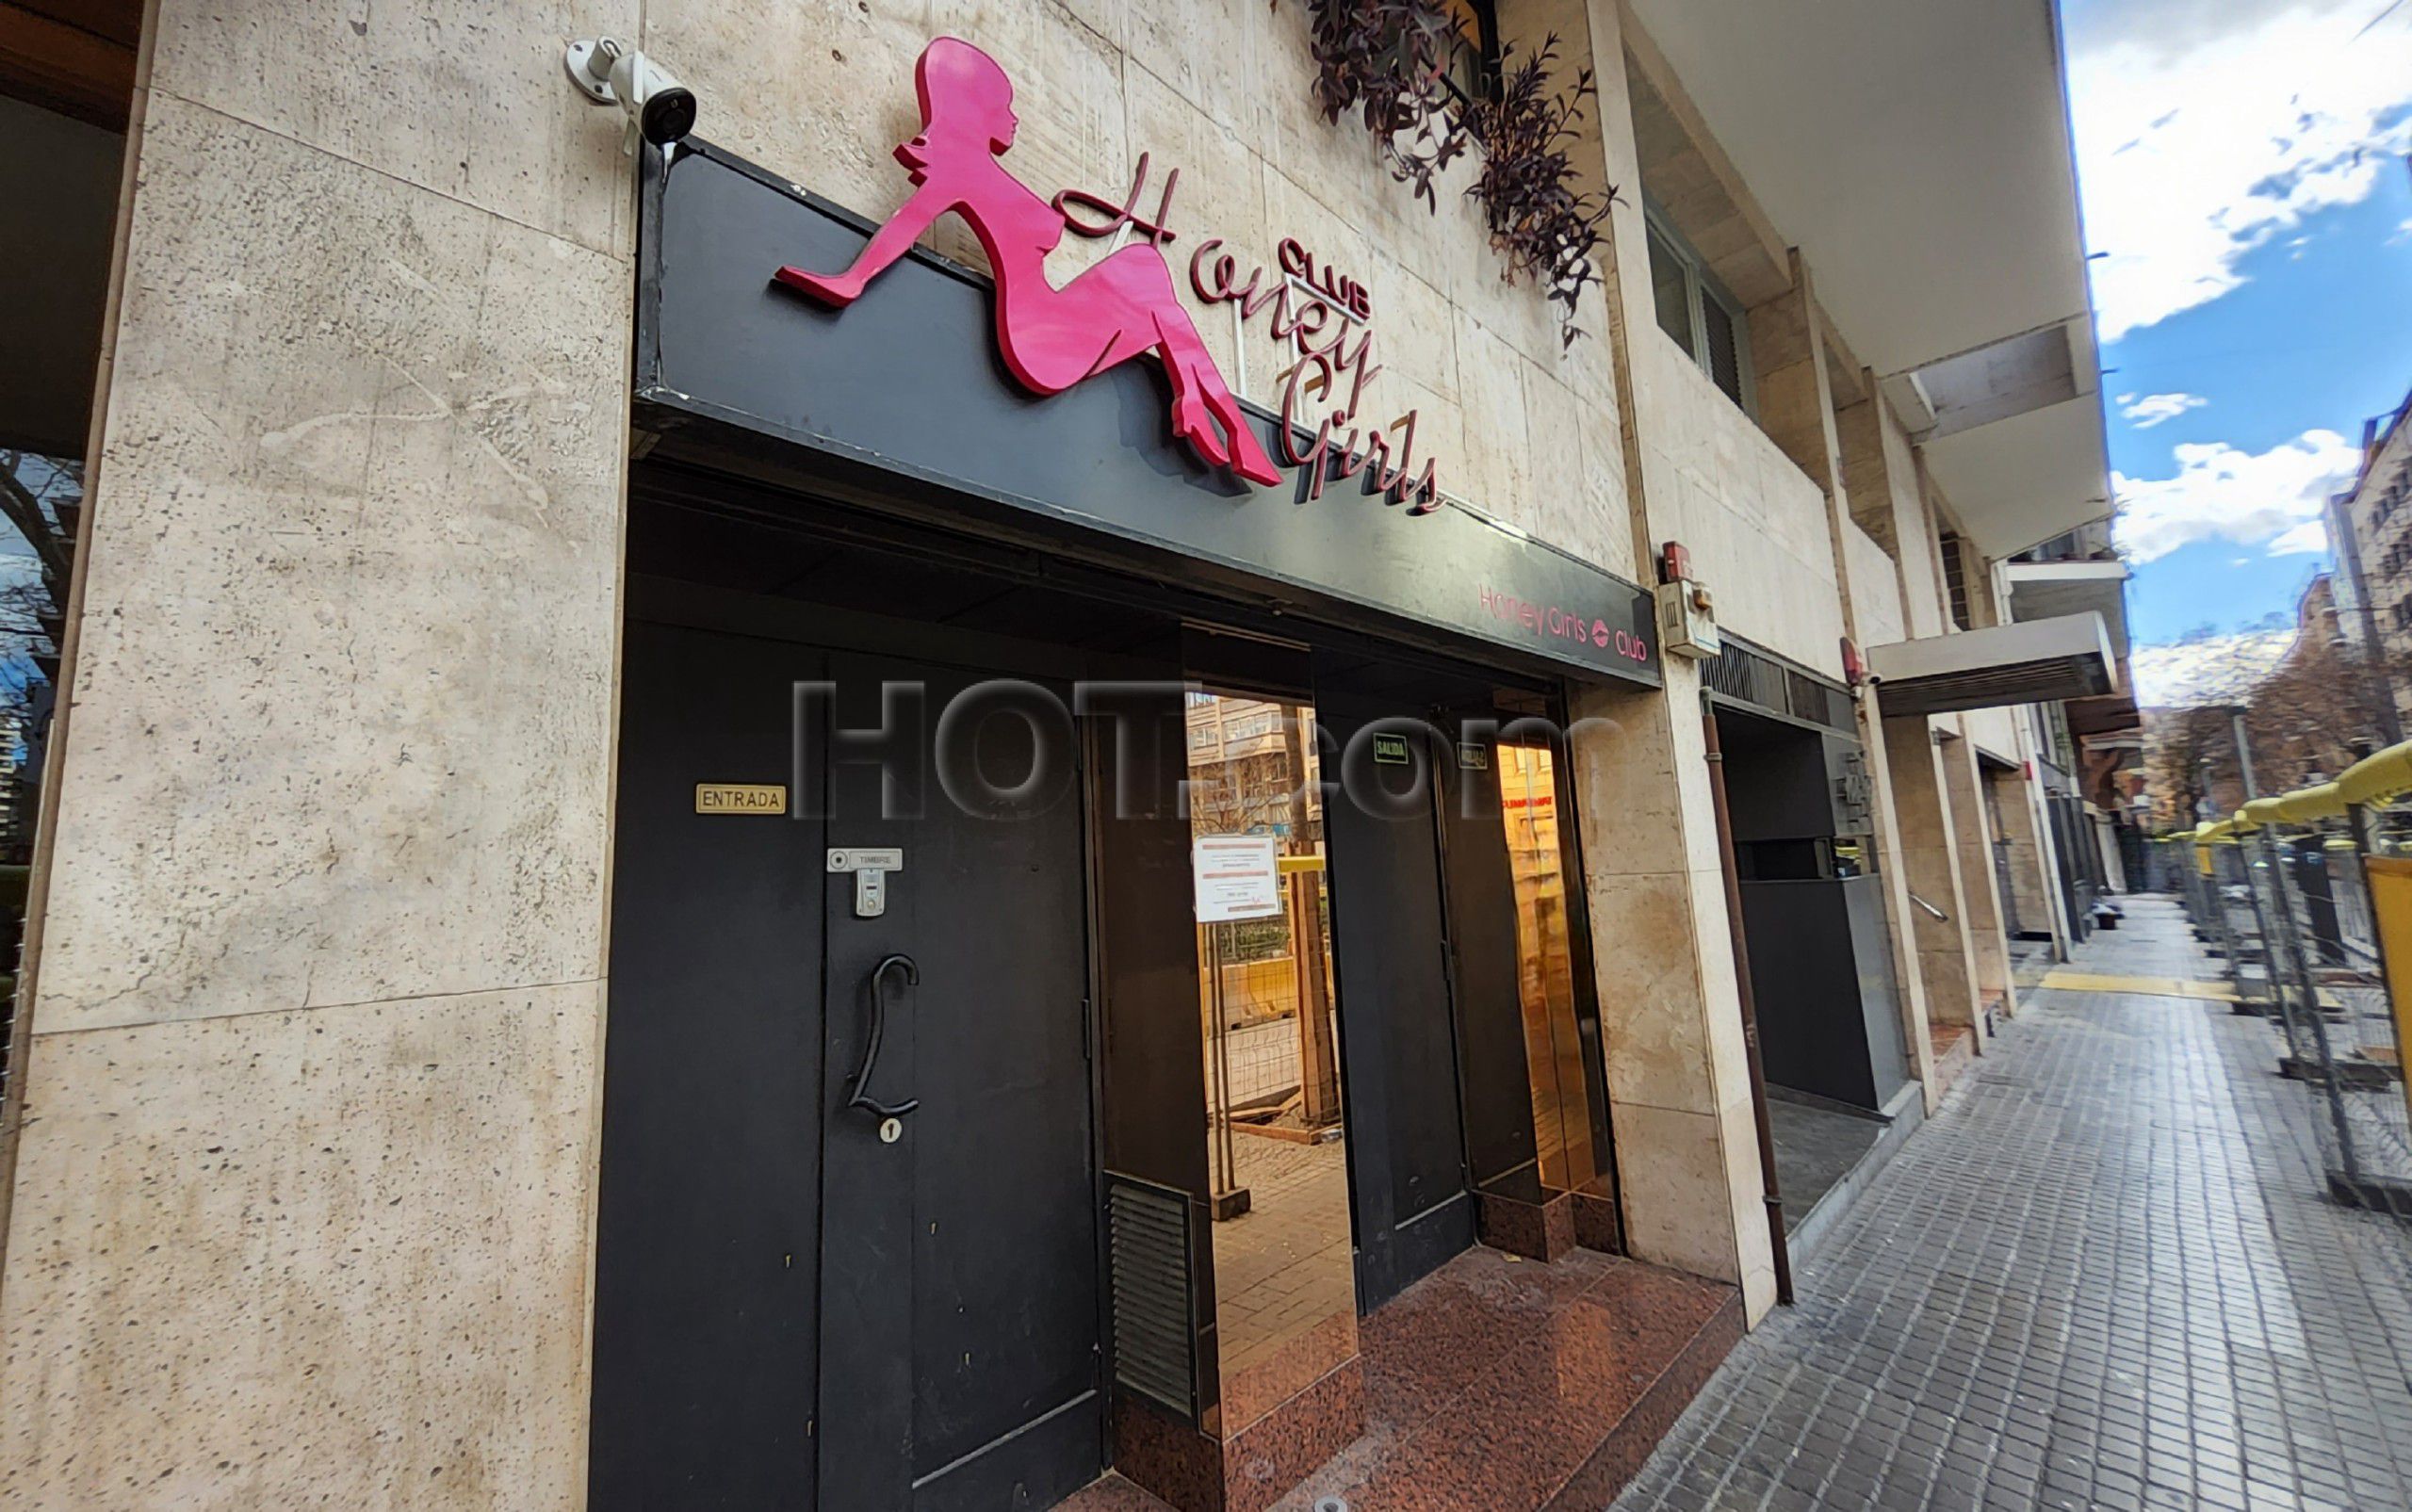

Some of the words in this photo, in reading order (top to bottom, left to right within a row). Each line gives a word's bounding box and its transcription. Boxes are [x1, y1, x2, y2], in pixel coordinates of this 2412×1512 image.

[1278, 236, 1371, 320] CLUB
[1281, 351, 1448, 512] Girls
[1478, 583, 1545, 637] Honey
[1548, 607, 1588, 643] Girls
[1615, 628, 1648, 662] Club
[1377, 740, 1406, 756] SALIDA
[702, 790, 780, 808] ENTRADA
